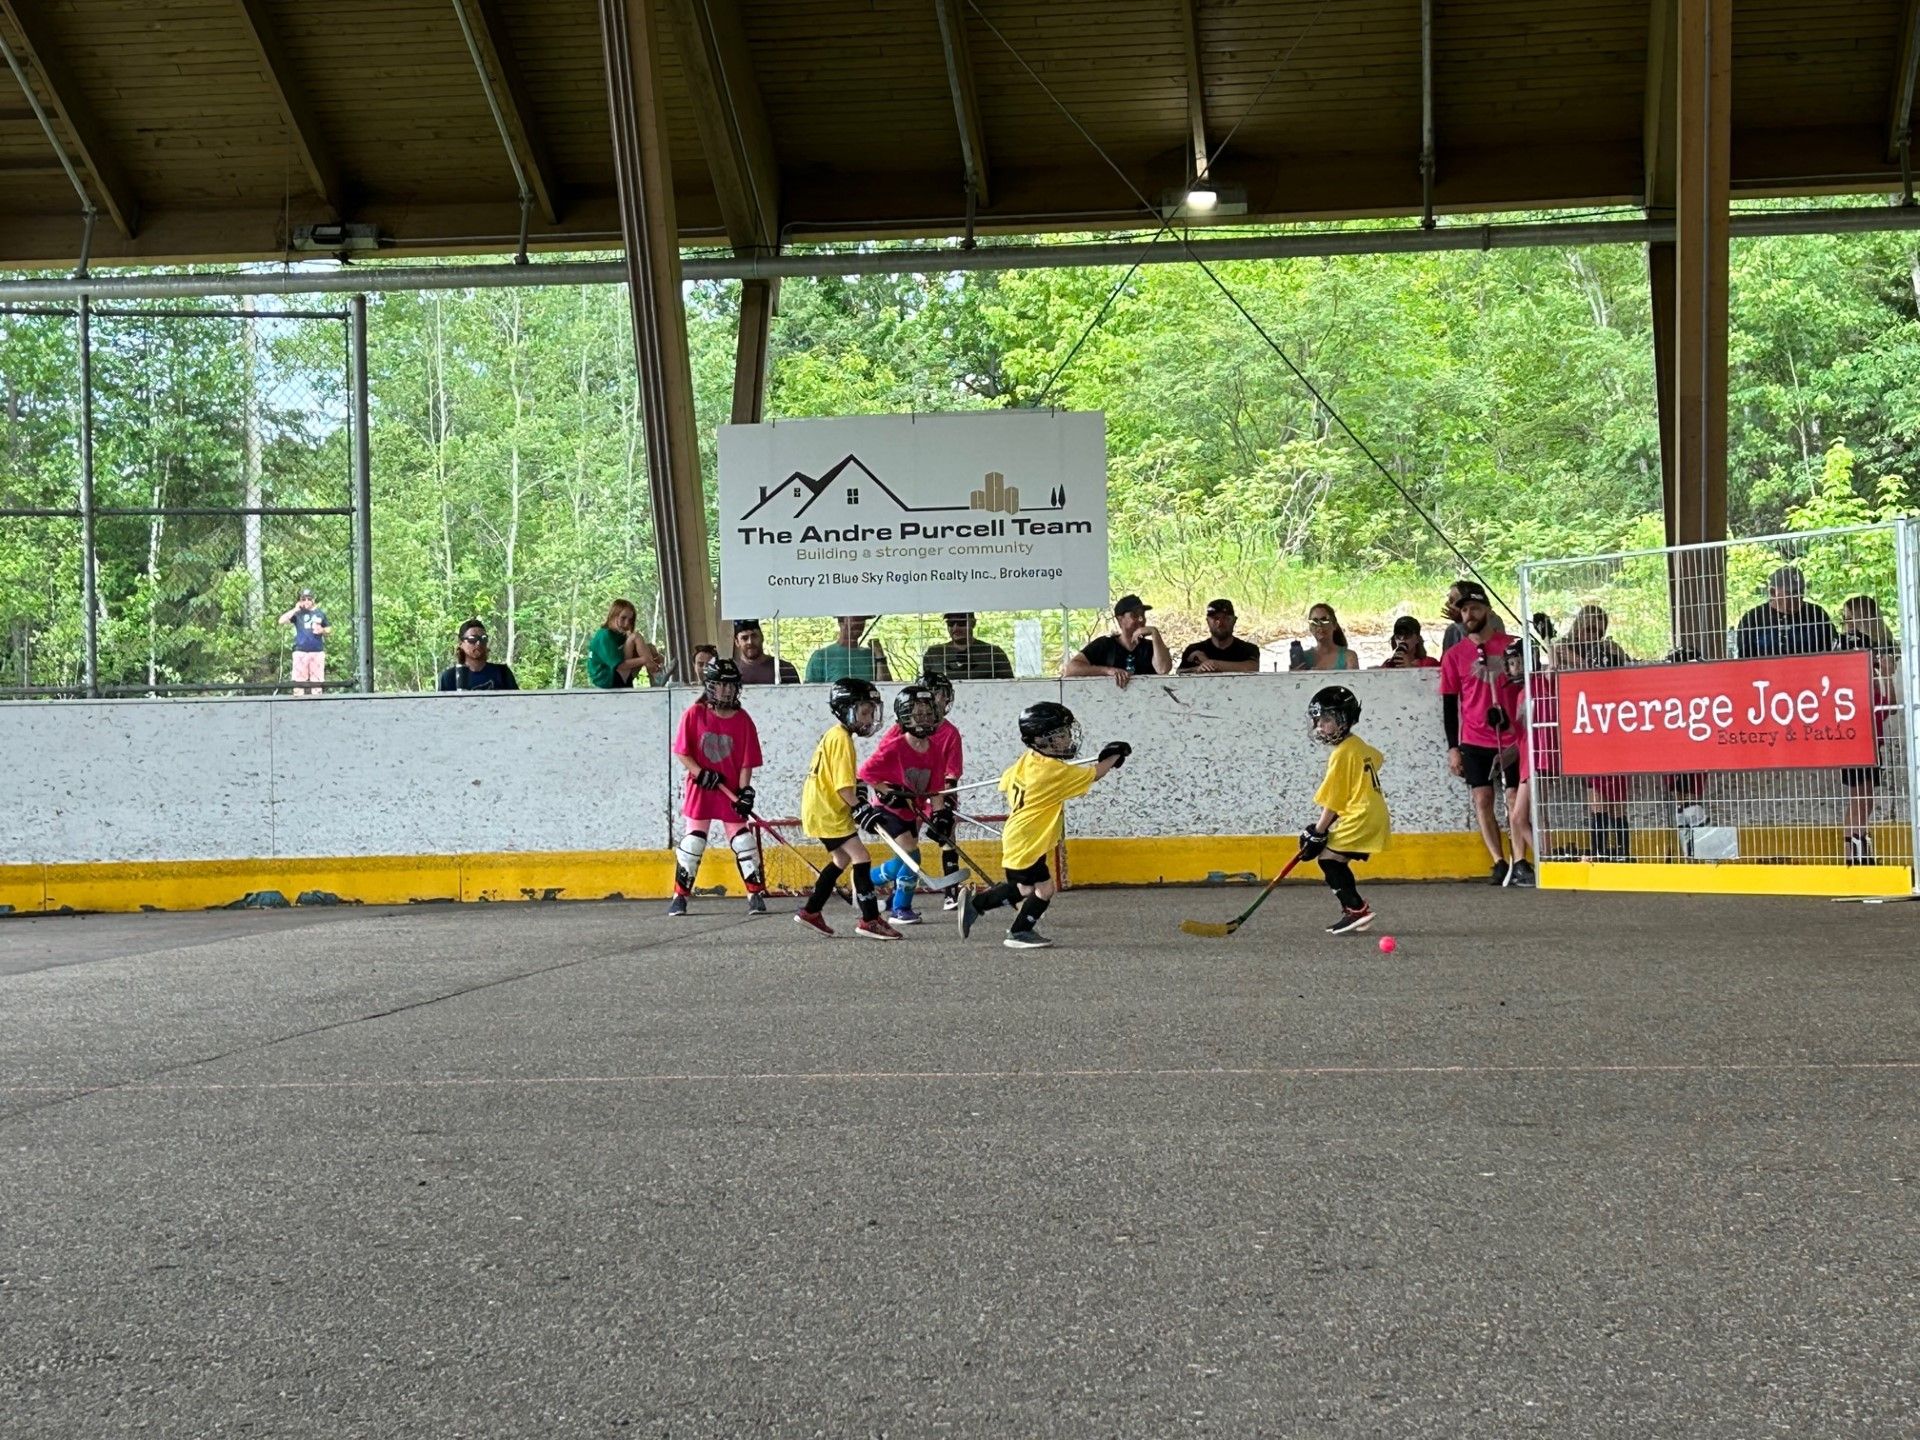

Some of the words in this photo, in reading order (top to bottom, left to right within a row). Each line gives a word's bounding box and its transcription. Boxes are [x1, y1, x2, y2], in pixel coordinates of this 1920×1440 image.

[737, 527, 792, 545] The
[799, 524, 892, 543] Andre
[900, 519, 1005, 540] Purcell
[1011, 518, 1092, 536] Team
[796, 547, 858, 561] Building
[862, 550, 871, 559] a
[876, 546, 943, 559] stronger
[948, 541, 1034, 556] community
[768, 574, 815, 588] Century
[817, 573, 830, 585] 21
[832, 573, 859, 584] Blue
[861, 571, 884, 585] Sky
[886, 570, 928, 584] Region
[930, 569, 968, 583] Realty
[1000, 566, 1063, 580] Brokerage
[1571, 690, 1734, 742] Average
[1747, 675, 1856, 726] Joe's
[1717, 729, 1779, 747] Eatery
[1785, 725, 1797, 742] &
[1804, 723, 1857, 741] Patio
